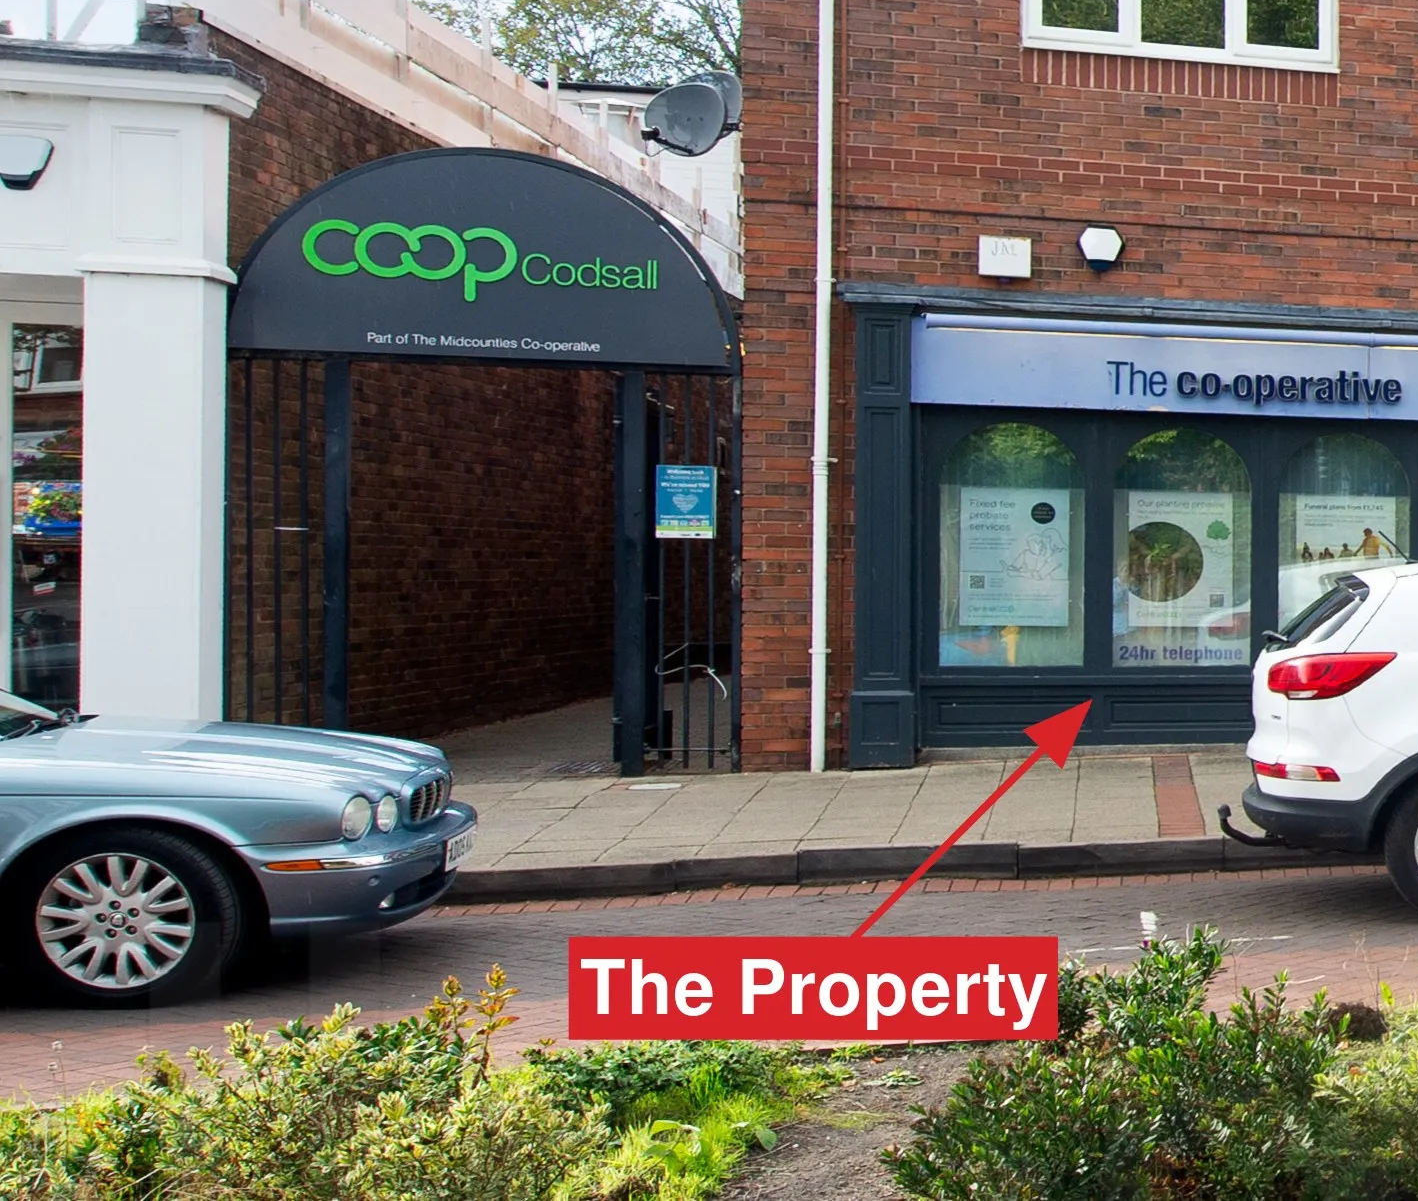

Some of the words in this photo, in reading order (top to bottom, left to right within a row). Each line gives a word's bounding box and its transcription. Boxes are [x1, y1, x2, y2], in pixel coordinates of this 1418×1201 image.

[521, 253, 658, 290] Codsall
[367, 332, 392, 345] Part
[396, 333, 410, 345] of
[411, 333, 437, 347] The
[440, 335, 518, 350] Midcounties
[521, 338, 601, 353] Co-operative
[1106, 361, 1168, 397] The
[1176, 370, 1403, 406] co-operative
[969, 499, 998, 509] Fixed
[999, 499, 1016, 509] fee
[1137, 499, 1153, 508] Our
[1155, 499, 1190, 509] planting
[1304, 503, 1329, 511] Funeral
[1329, 503, 1346, 511] plans
[1347, 503, 1362, 511] from
[969, 511, 1009, 521] probate
[968, 522, 1012, 532] services
[1119, 645, 1157, 661] 24hr
[1162, 646, 1243, 663] telephone
